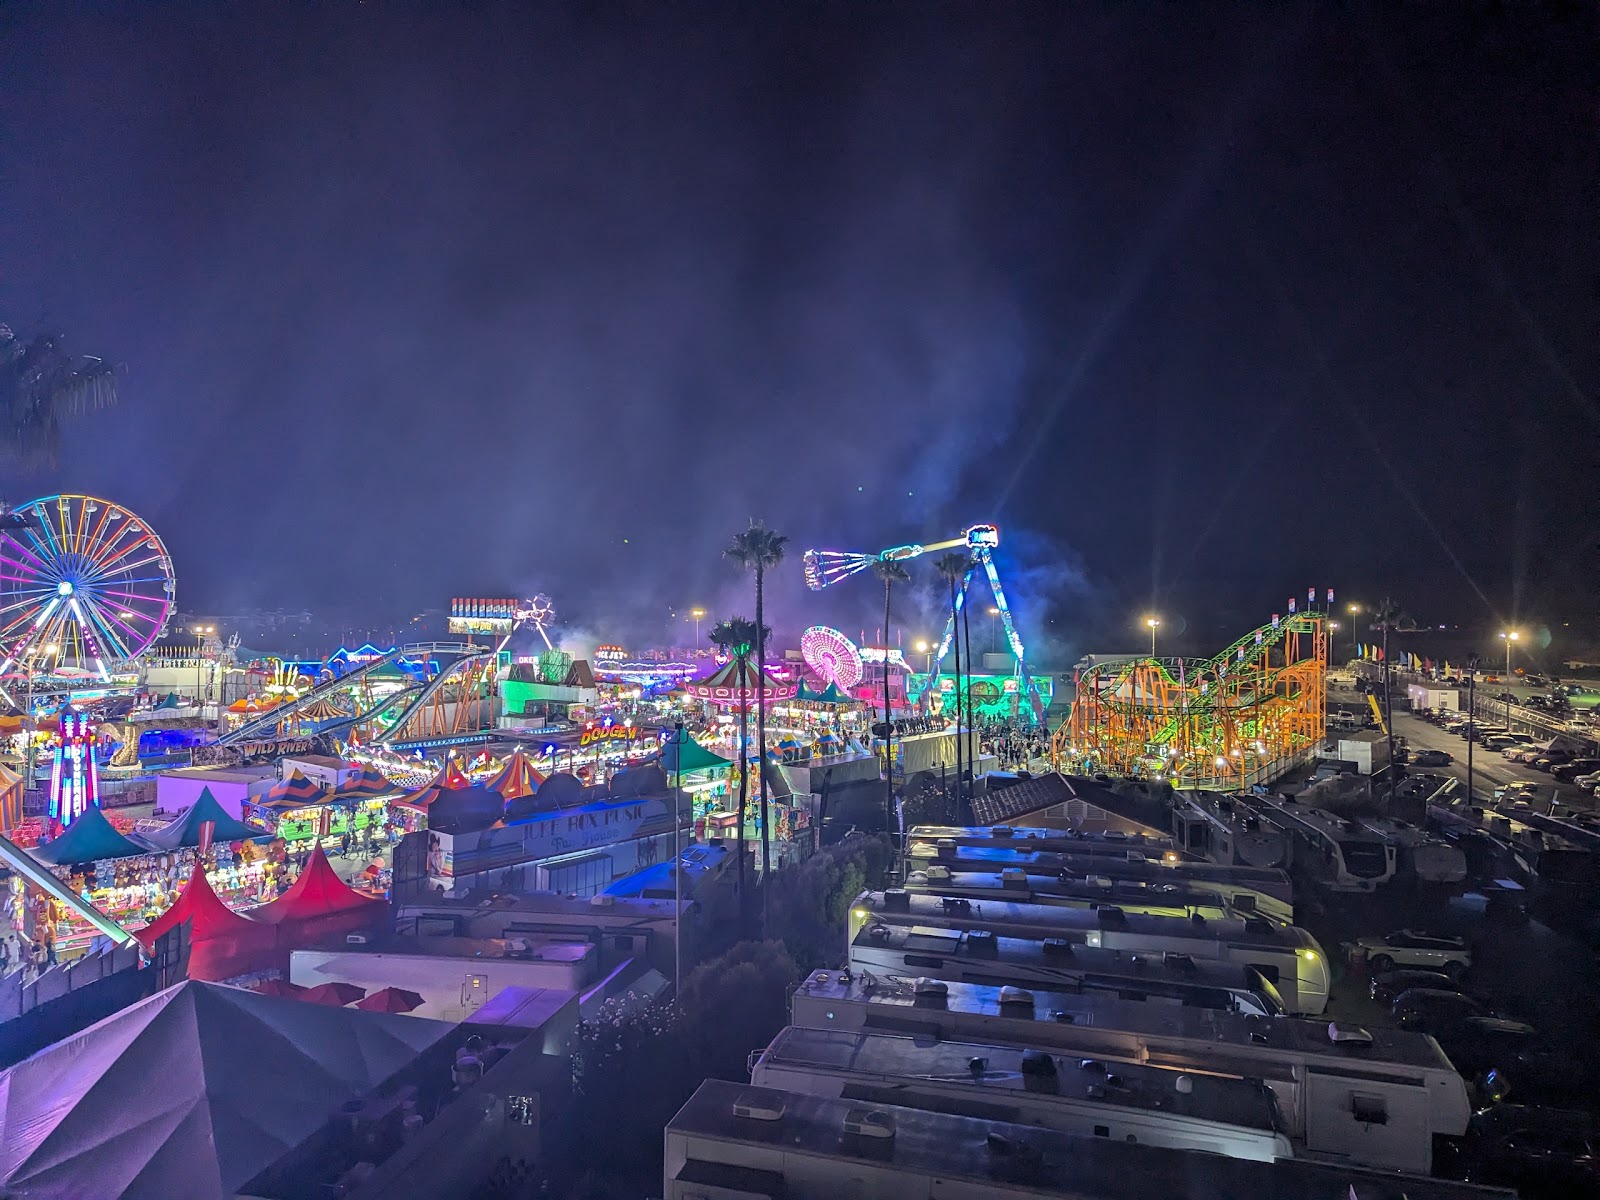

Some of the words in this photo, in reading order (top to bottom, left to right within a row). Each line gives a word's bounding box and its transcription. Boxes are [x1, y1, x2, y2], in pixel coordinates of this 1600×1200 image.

[580, 724, 638, 746] DODGEM
[243, 742, 276, 757] WILD
[277, 740, 309, 755] RIVER
[524, 820, 561, 840] JUKE
[568, 813, 598, 832] BOX
[605, 805, 646, 826] MUSIC
